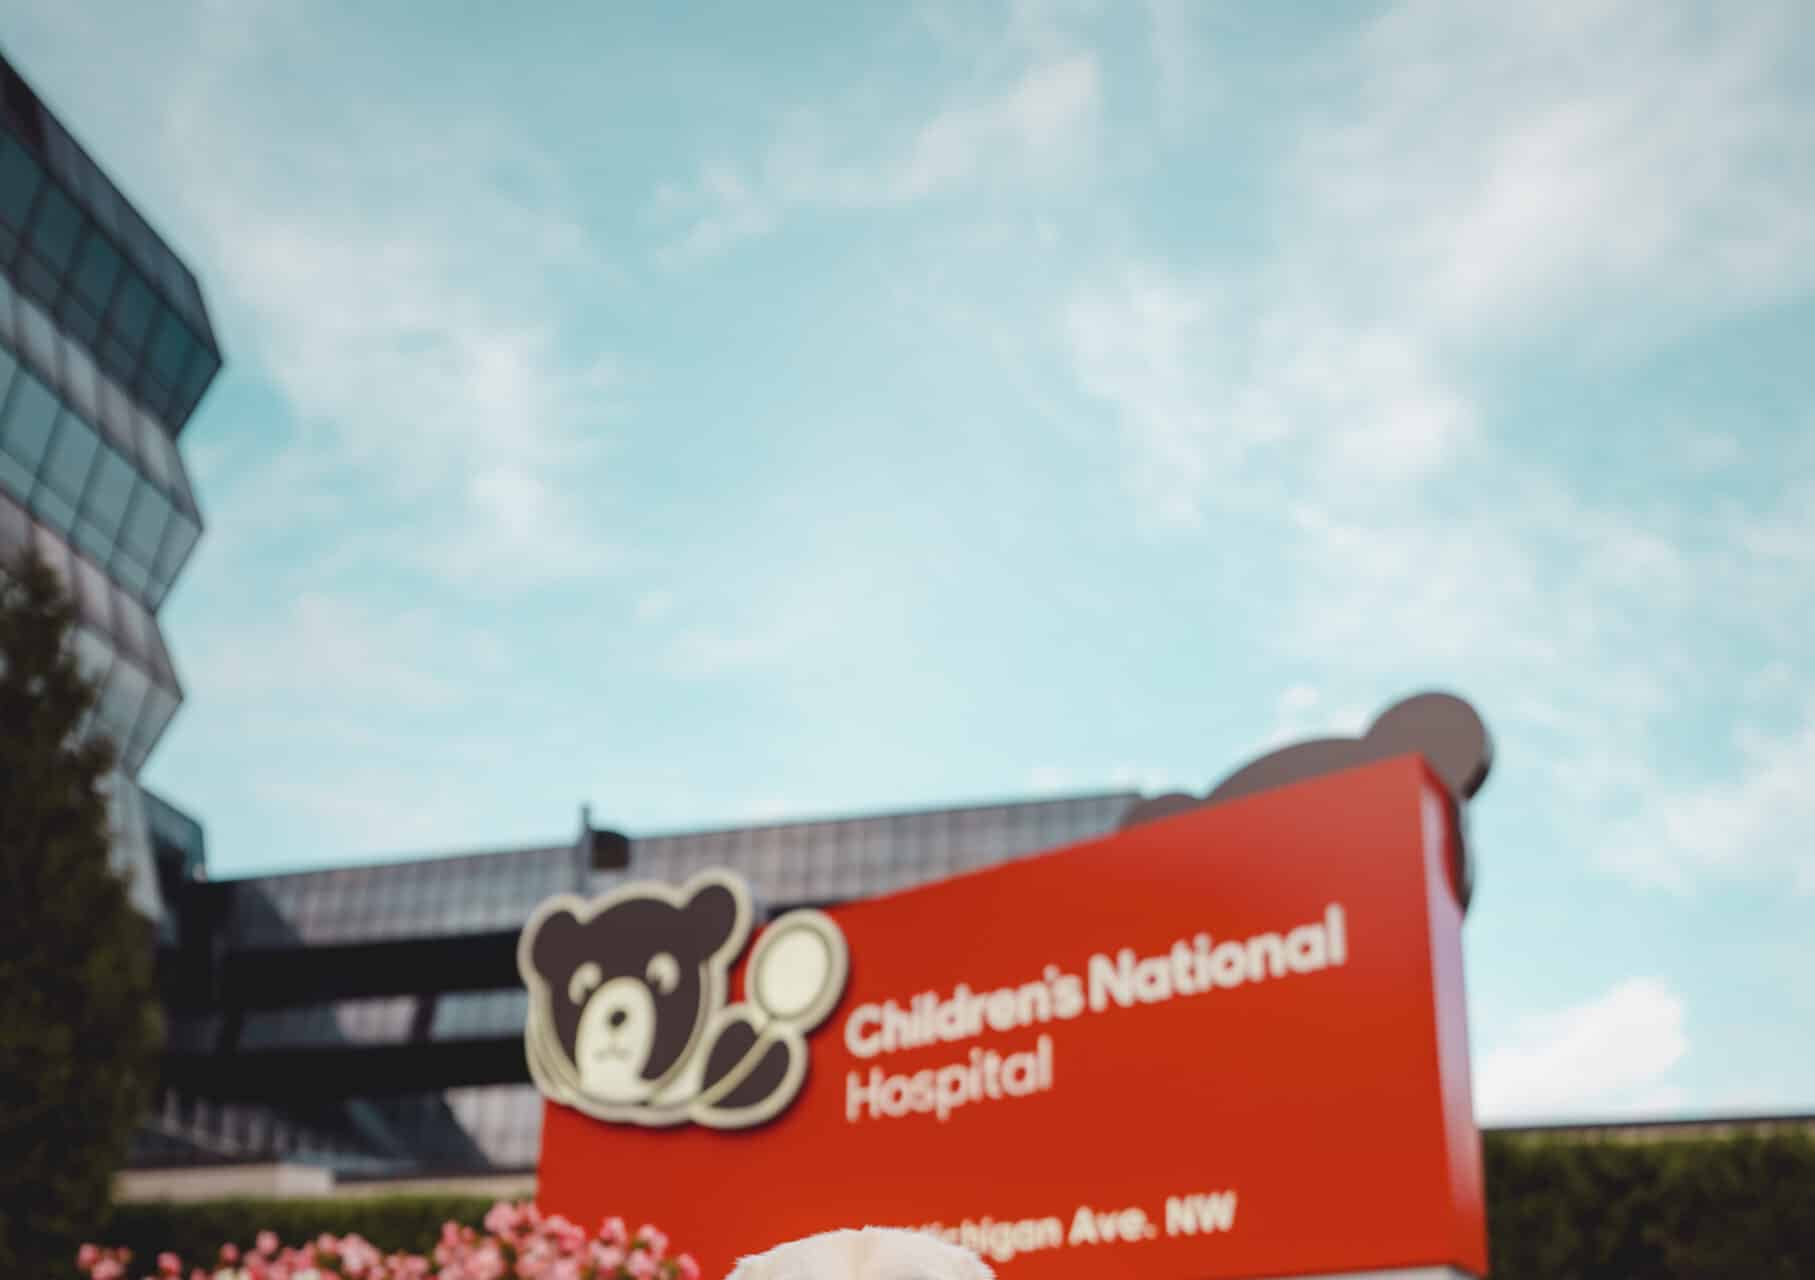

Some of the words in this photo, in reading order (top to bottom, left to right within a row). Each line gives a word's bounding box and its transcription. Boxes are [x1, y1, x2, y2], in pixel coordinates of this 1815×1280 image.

[845, 965, 1085, 1058] Children's
[1088, 901, 1347, 1013] National
[845, 1034, 1054, 1122] Hospital
[1068, 1206, 1157, 1248] Ave.
[1165, 1190, 1237, 1237] NW
